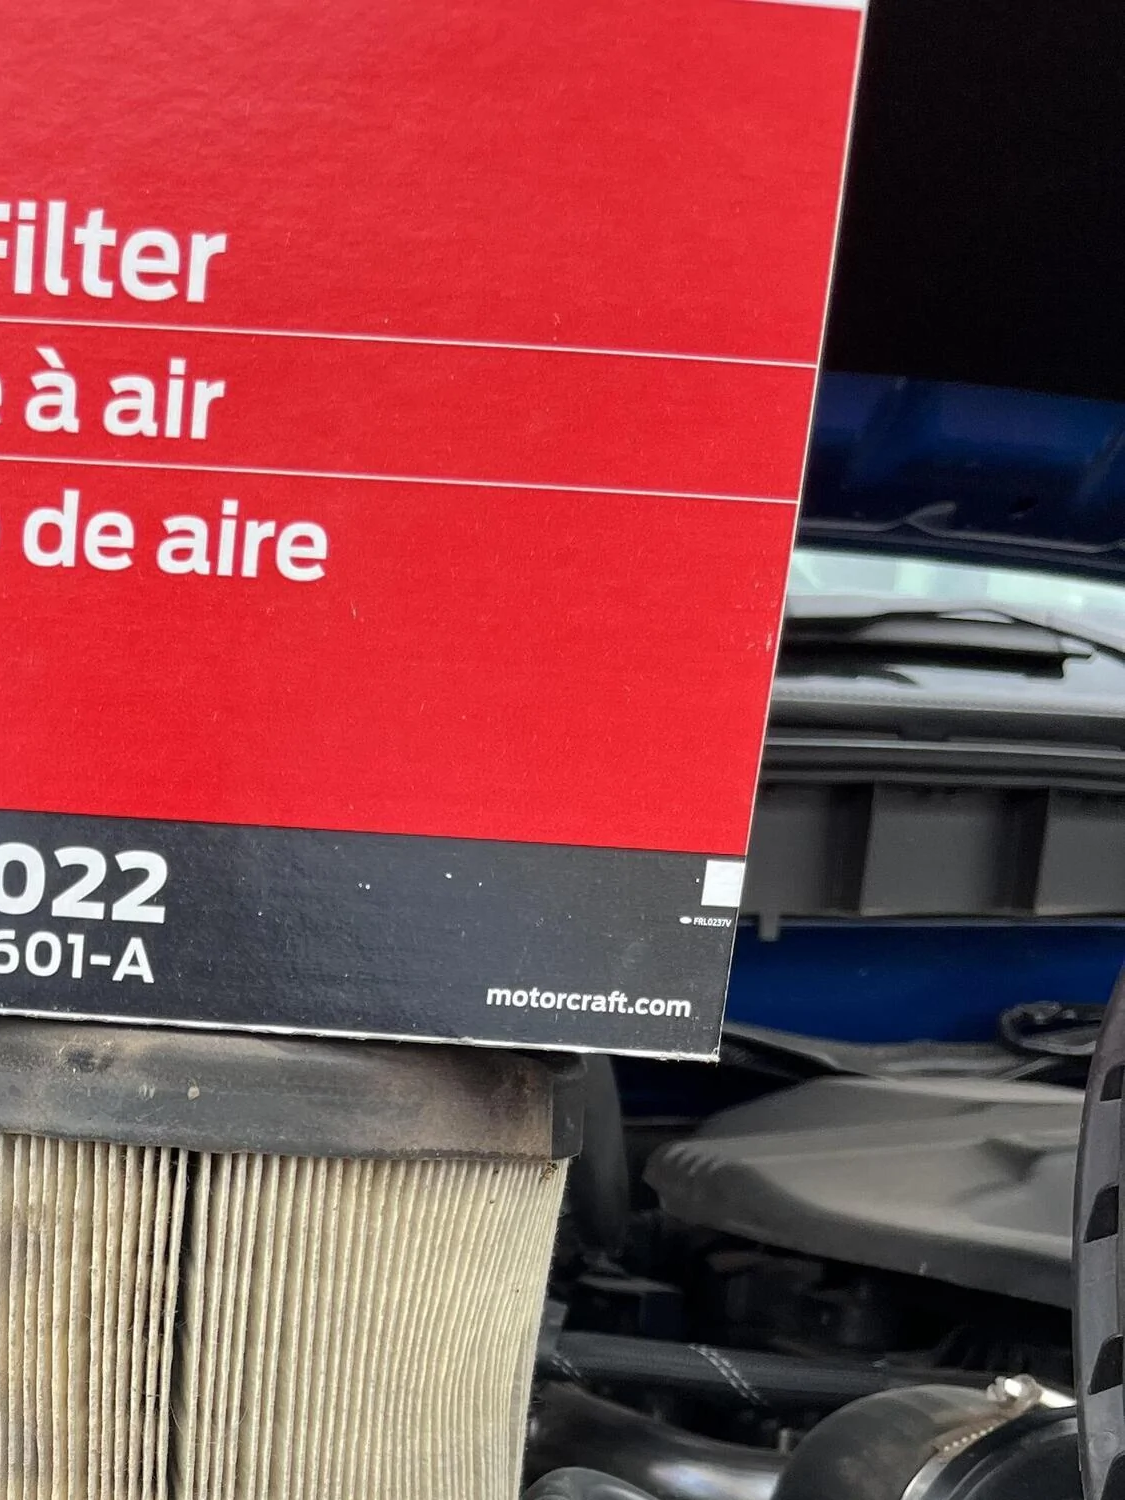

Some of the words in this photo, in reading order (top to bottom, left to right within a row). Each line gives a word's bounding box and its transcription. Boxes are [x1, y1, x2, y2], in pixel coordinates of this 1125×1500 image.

[25, 347, 80, 433] à
[103, 358, 226, 440] air
[22, 489, 135, 571] de
[156, 499, 328, 582] aire
[692, 915, 733, 929] FRL0237V
[484, 985, 693, 1018] motorcraft.com
